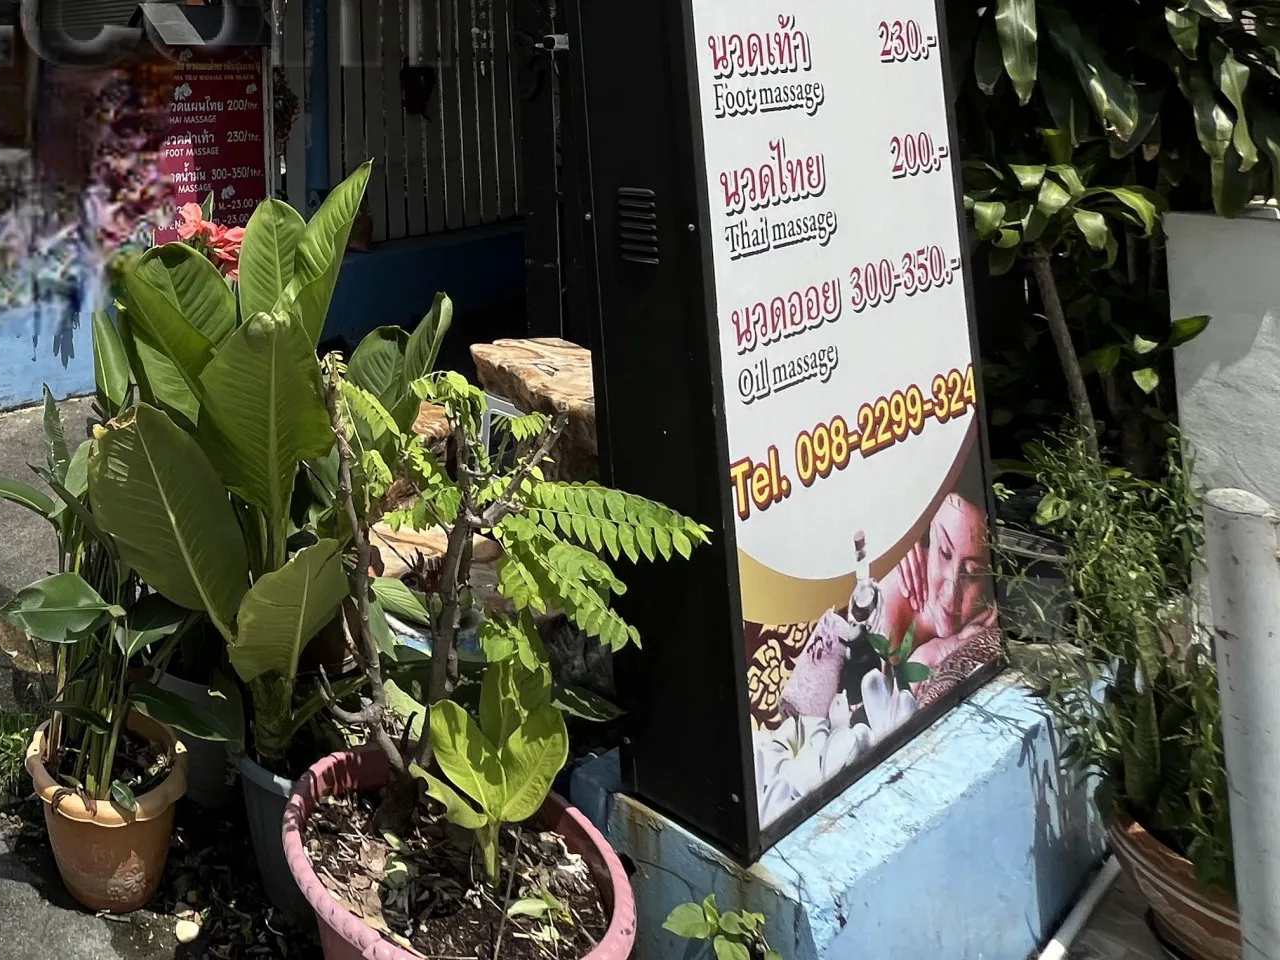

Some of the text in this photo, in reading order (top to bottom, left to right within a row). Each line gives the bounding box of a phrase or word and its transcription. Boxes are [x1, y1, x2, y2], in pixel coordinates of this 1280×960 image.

[708, 14, 938, 78] นวดเท้า 230.-
[170, 96, 224, 112] วดแผนไทย
[184, 114, 217, 124] MASSAGE
[714, 80, 825, 118] Foot massage
[165, 146, 220, 157] FOOT MASSAGE
[720, 131, 949, 216] นวดไทย 200.-
[177, 183, 213, 194] MASSAGE
[725, 208, 838, 259] Thai massage
[732, 245, 961, 354] นวดออย 300-350.-
[738, 343, 839, 404] Oil massage
[729, 363, 977, 519] Tel. 098-2299-324
